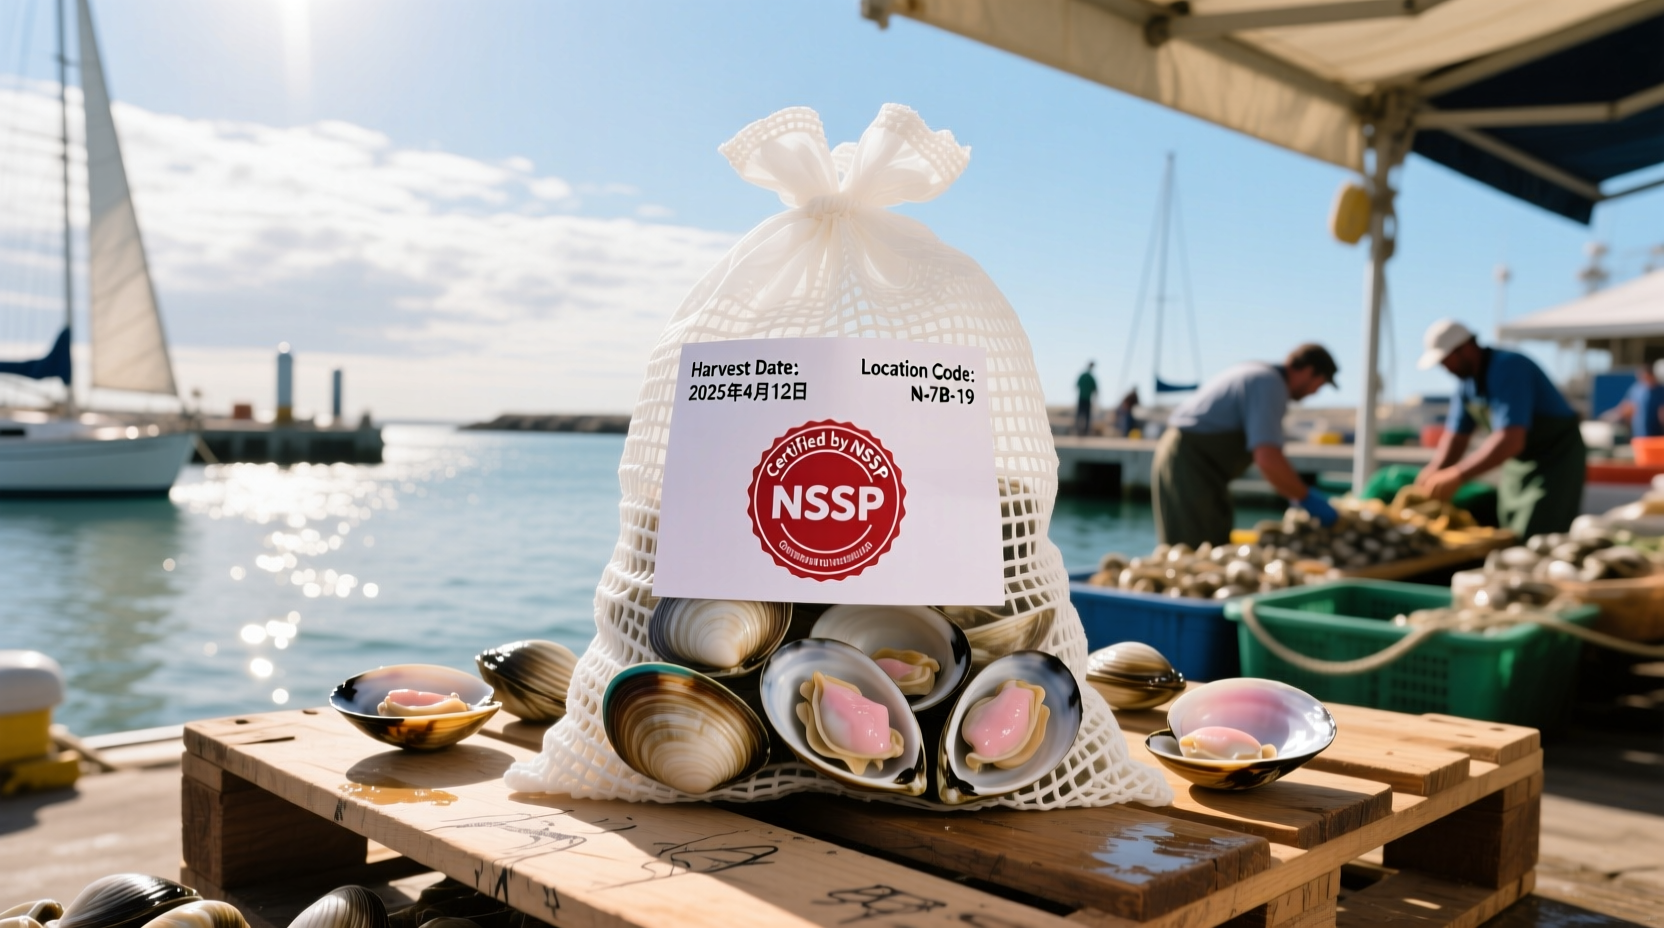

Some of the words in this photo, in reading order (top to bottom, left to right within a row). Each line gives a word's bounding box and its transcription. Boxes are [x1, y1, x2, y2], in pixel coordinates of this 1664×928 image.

[691, 360, 751, 377] Harvest
[755, 359, 799, 376] Date:
[861, 358, 928, 379] Location
[932, 363, 975, 383] Code:
[688, 382, 807, 402] 2025年4月12日
[911, 385, 975, 405] N-7B-19
[830, 431, 849, 452] by
[850, 439, 889, 479] NSSP
[771, 484, 885, 521] NSSP
